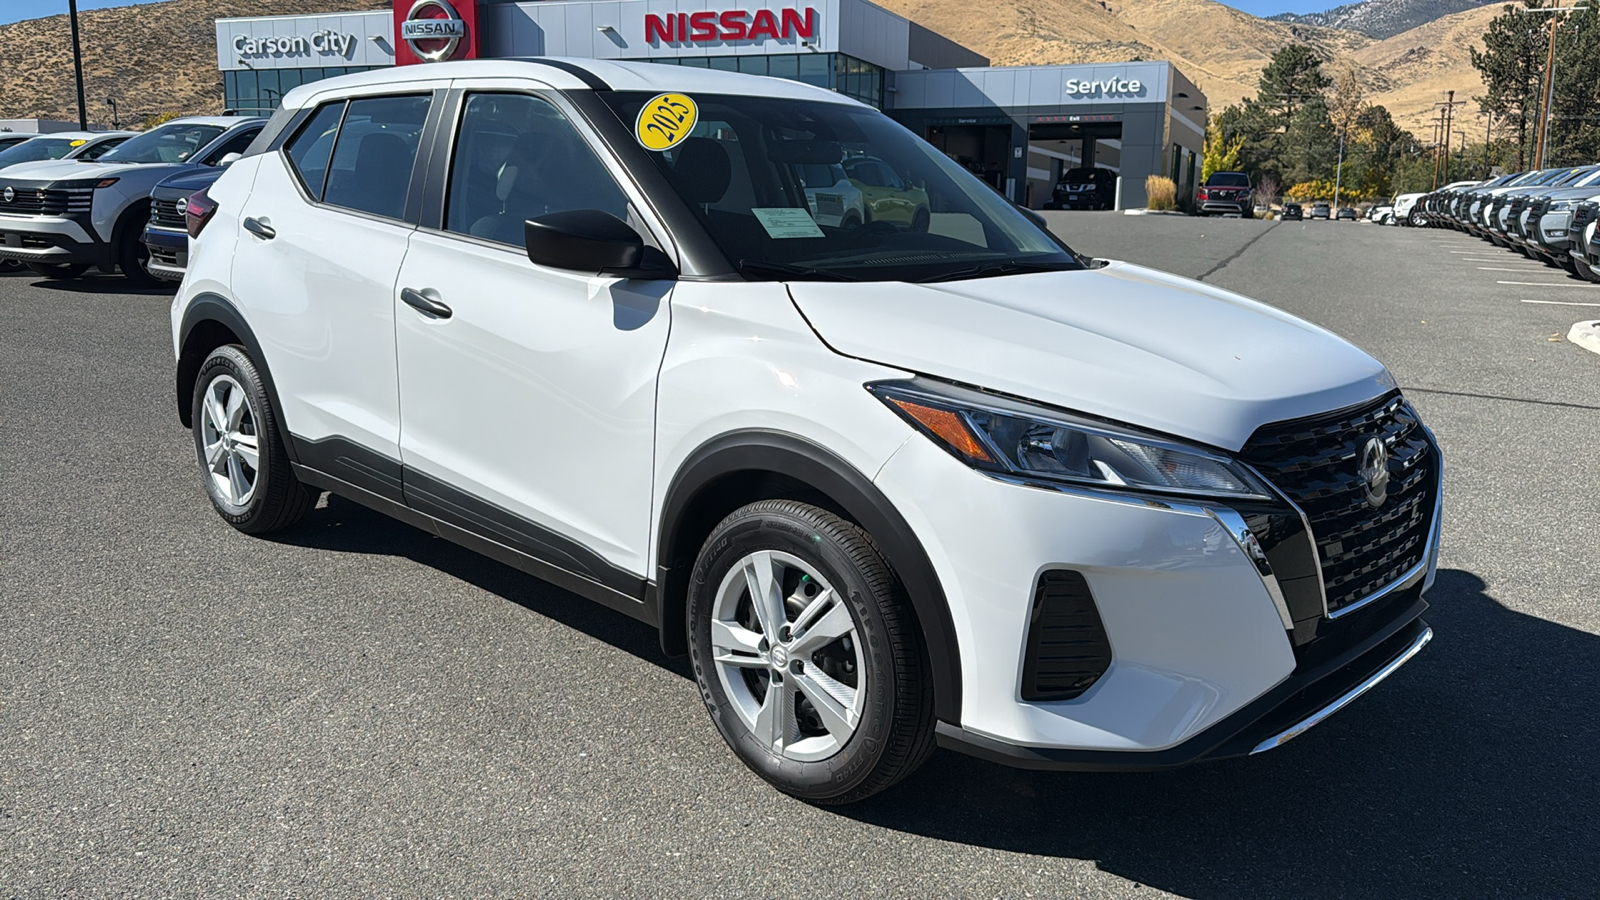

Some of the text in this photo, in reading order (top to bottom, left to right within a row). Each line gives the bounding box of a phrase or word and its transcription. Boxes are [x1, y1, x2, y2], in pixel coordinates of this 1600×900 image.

[405, 23, 455, 34] NISSAN
[644, 7, 813, 43] NISSAN
[232, 29, 351, 56] Carson City
[1066, 75, 1140, 94] Service
[647, 97, 690, 142] 2025
